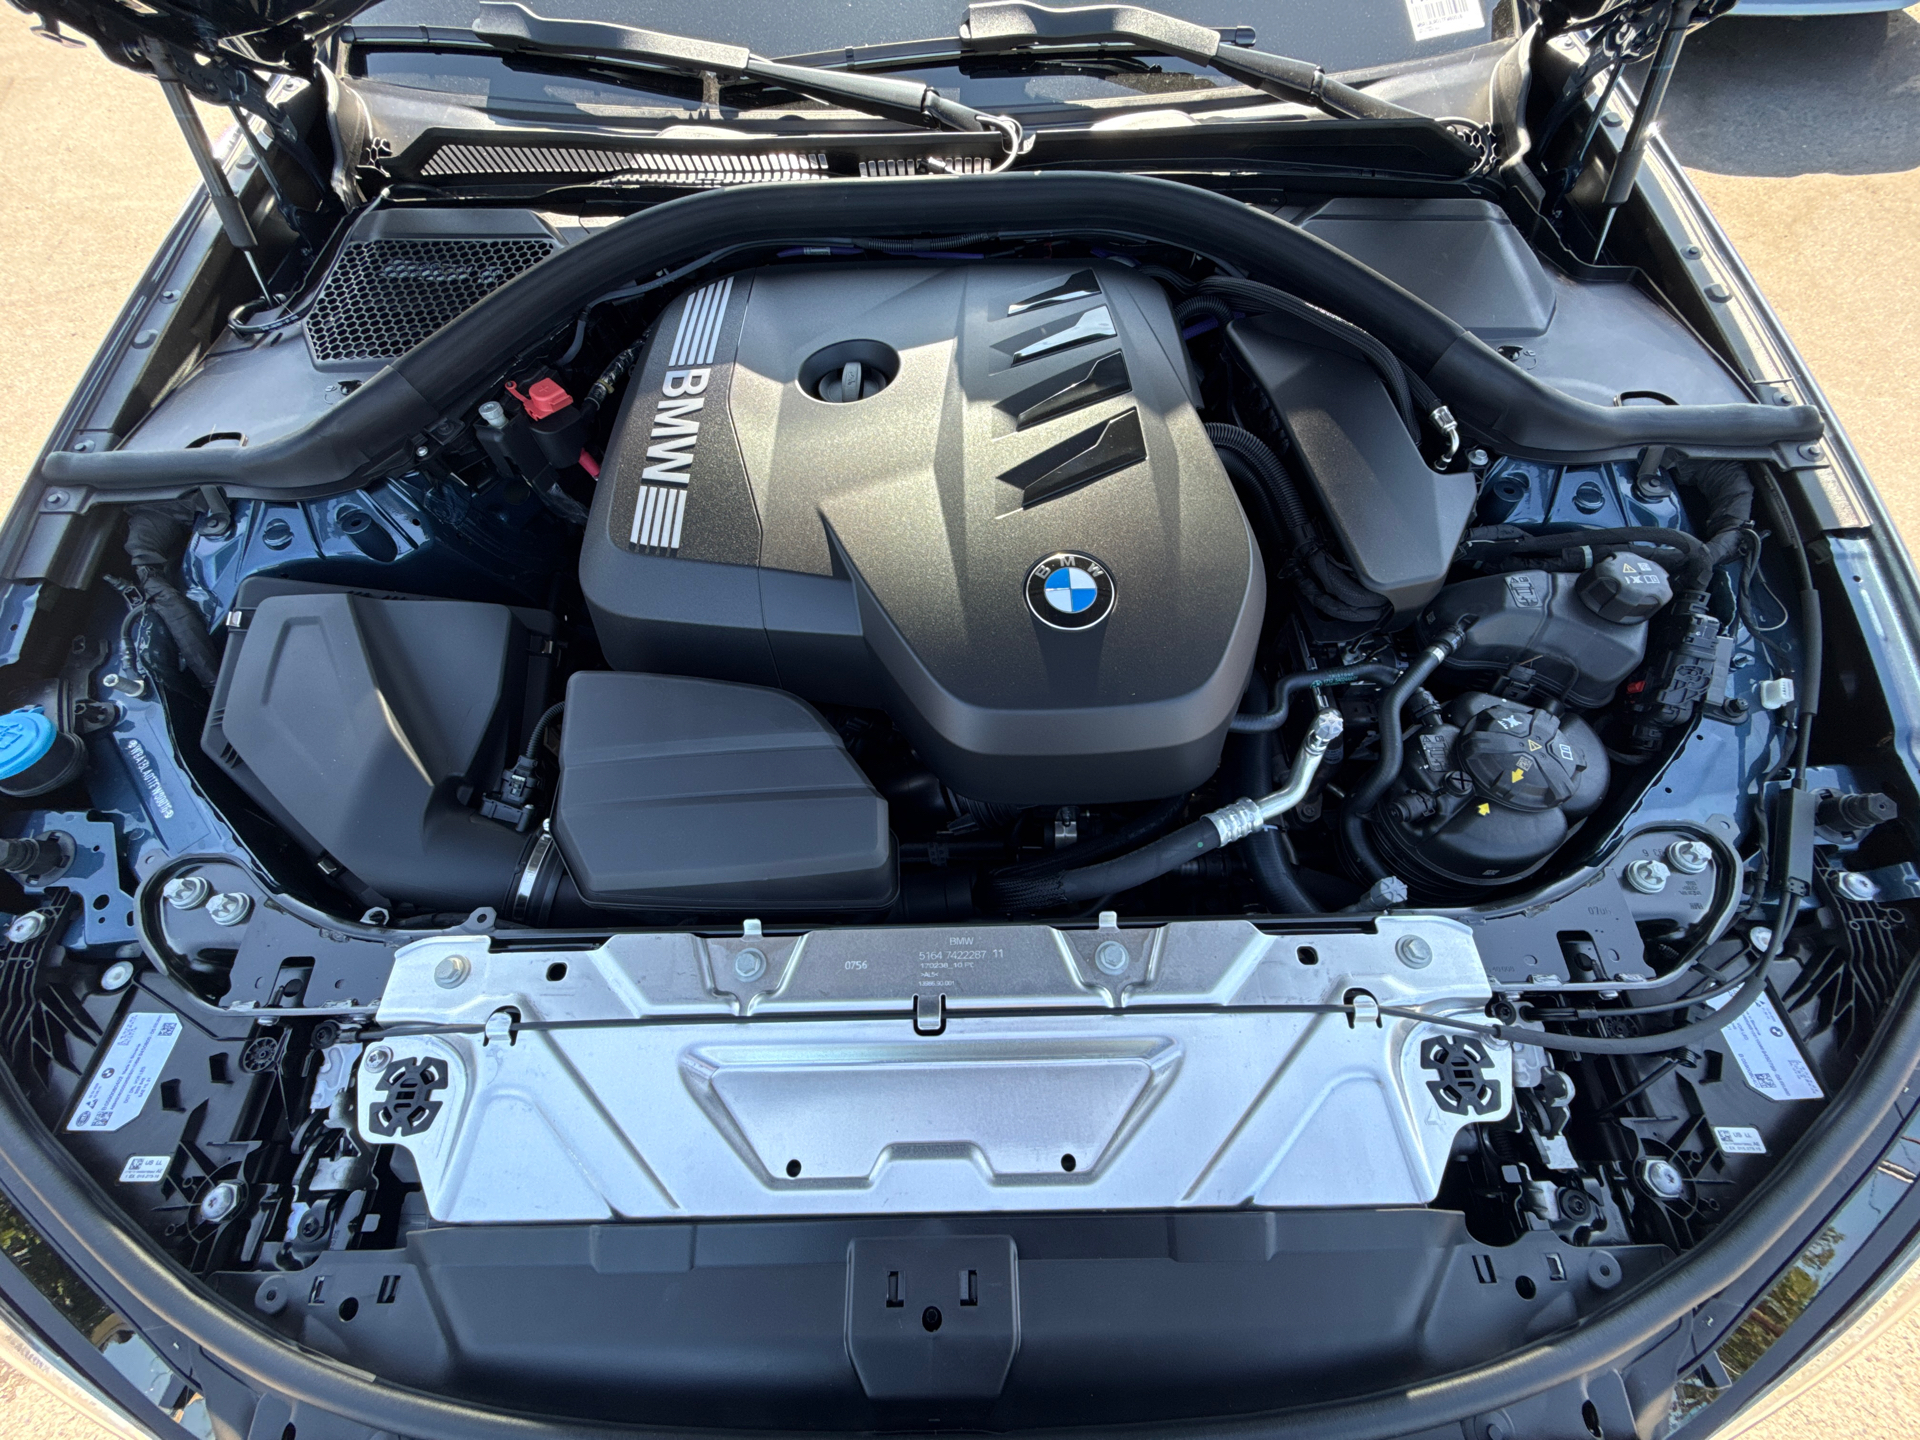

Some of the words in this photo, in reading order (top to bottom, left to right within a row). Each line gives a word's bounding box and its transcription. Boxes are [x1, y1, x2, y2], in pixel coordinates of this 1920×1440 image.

[642, 368, 711, 484] BMW
[1034, 556, 1104, 579] BMW
[950, 937, 974, 946] BMW
[919, 952, 943, 960] 5164
[946, 950, 986, 960] 7422287
[992, 949, 1004, 958] 11
[844, 960, 868, 970] 0756
